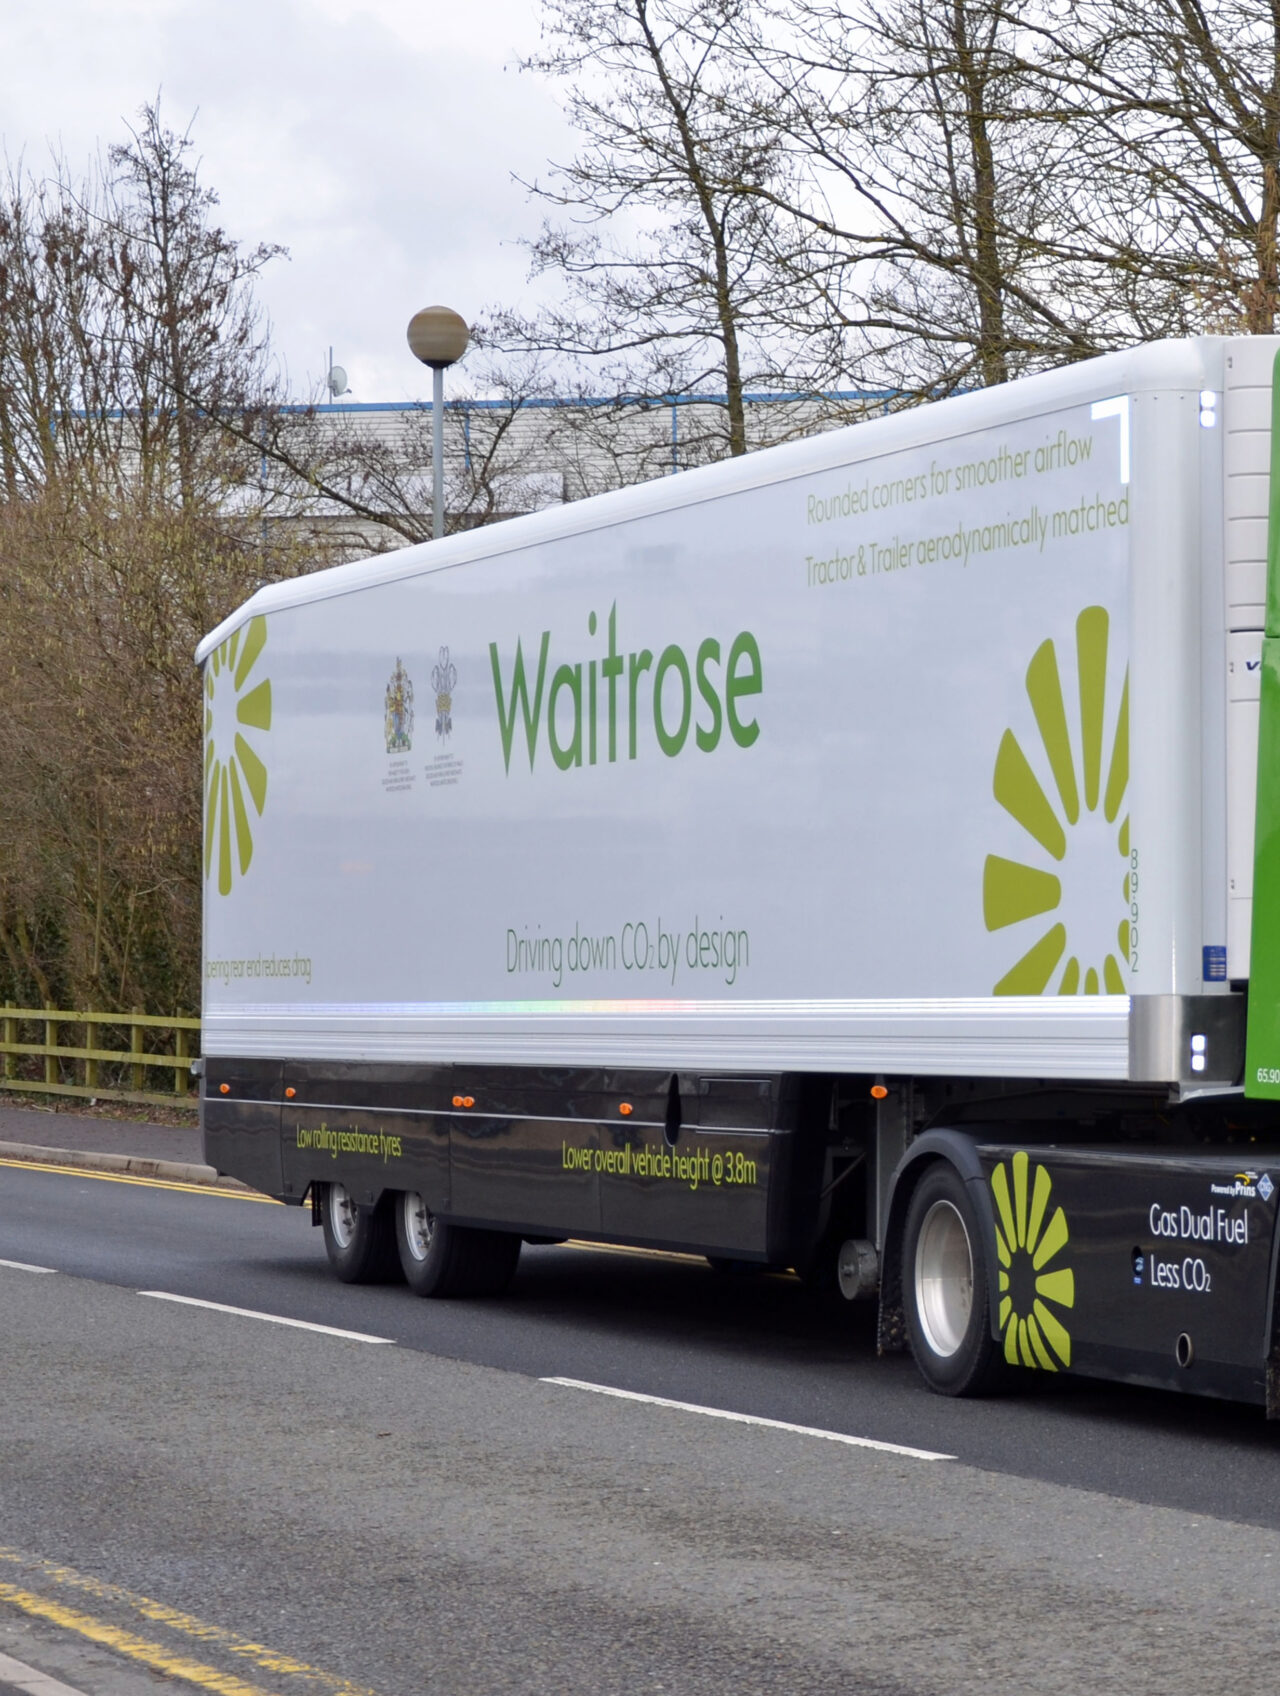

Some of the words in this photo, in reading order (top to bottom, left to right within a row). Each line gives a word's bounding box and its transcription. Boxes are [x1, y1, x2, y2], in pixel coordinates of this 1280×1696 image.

[807, 477, 869, 525] Rounded
[872, 475, 927, 509] corners
[931, 460, 952, 497] for
[955, 444, 1031, 491] smoother
[1034, 430, 1093, 473] airflow
[805, 547, 855, 588] Tractor
[857, 545, 866, 576] &
[869, 534, 915, 575] Trailer
[916, 505, 1048, 568] aerodynamically
[1052, 486, 1129, 538] matched
[488, 597, 763, 779] Waitrose
[506, 923, 563, 988] Driving
[567, 920, 617, 971] down
[657, 917, 681, 986] by
[685, 914, 749, 985] design
[296, 1122, 313, 1149] Low
[313, 1122, 337, 1159] rolling
[338, 1124, 379, 1154] resistance
[380, 1127, 402, 1164] tyres
[562, 1140, 593, 1171] Lower
[594, 1142, 630, 1174] overall
[632, 1143, 671, 1178] vehicle
[673, 1145, 709, 1190] height
[712, 1153, 723, 1186] @
[725, 1151, 757, 1184] 3.8m
[1235, 1181, 1256, 1197] Prins
[1149, 1203, 1178, 1237] Gas
[1180, 1205, 1214, 1241] Dual
[1217, 1208, 1248, 1244] Fuel
[1150, 1253, 1180, 1288] Less
